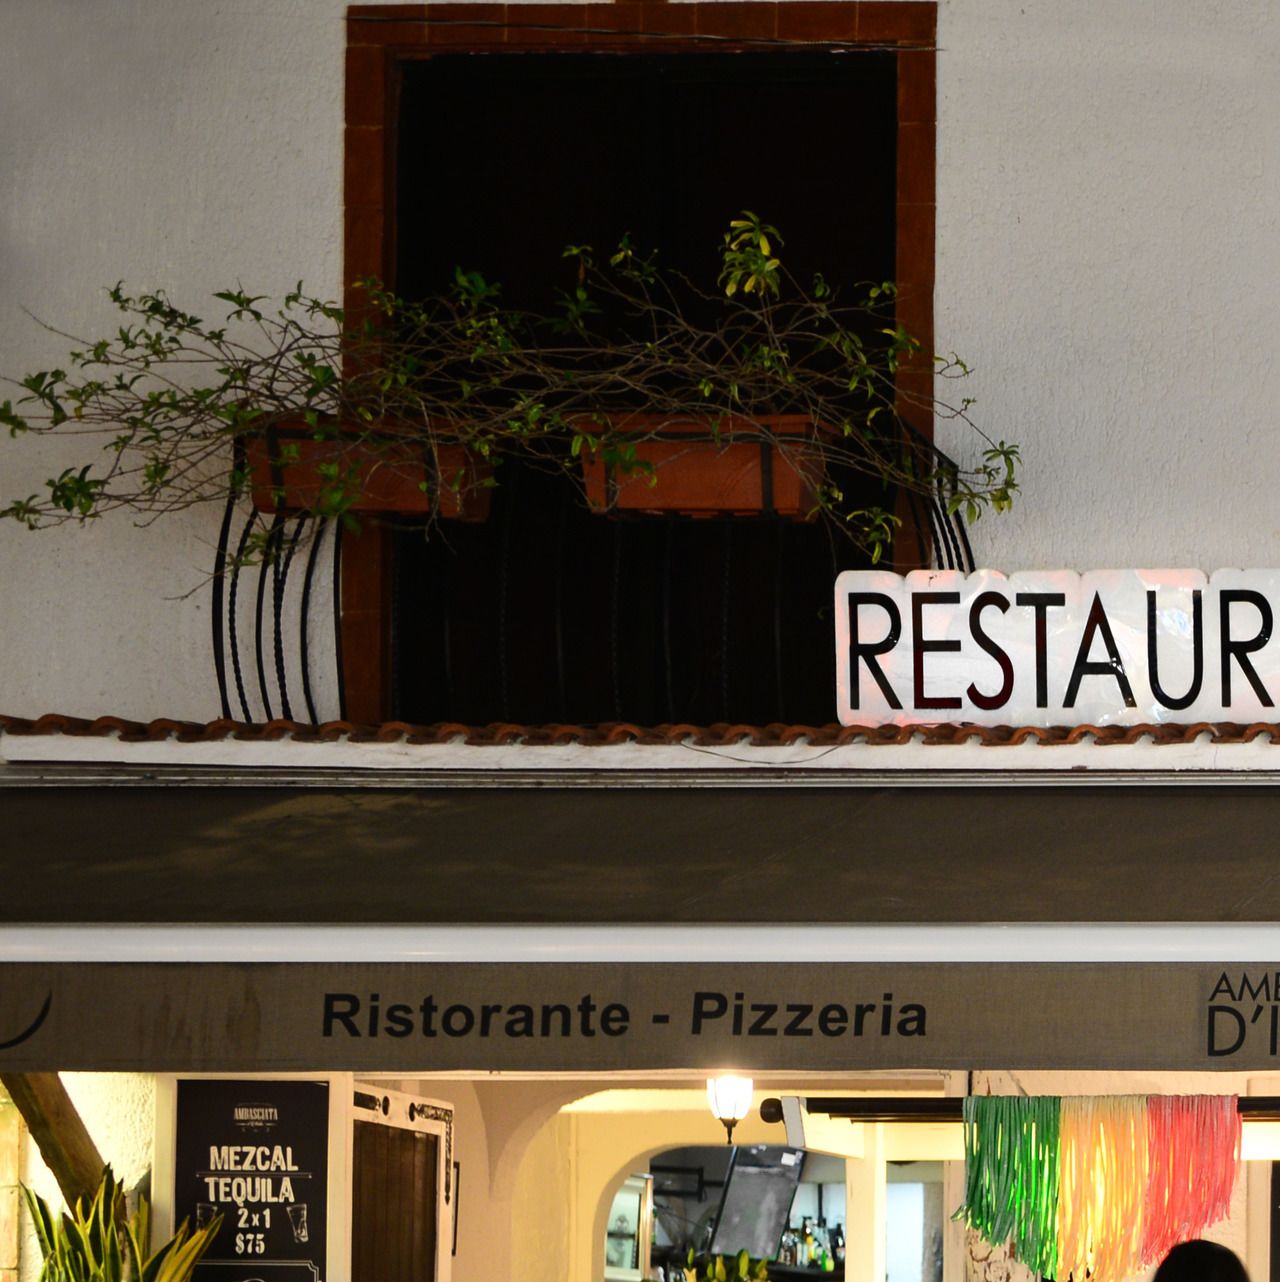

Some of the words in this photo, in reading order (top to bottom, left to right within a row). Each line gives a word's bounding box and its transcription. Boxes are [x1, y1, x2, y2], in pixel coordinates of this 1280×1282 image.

[322, 992, 630, 1038] Ristorante
[691, 991, 929, 1036] Pizzeria
[234, 1107, 278, 1121] AMBASCIATA
[209, 1145, 299, 1171] MEZCAL
[204, 1176, 295, 1207] TEQUILA
[235, 1232, 265, 1254] $75
